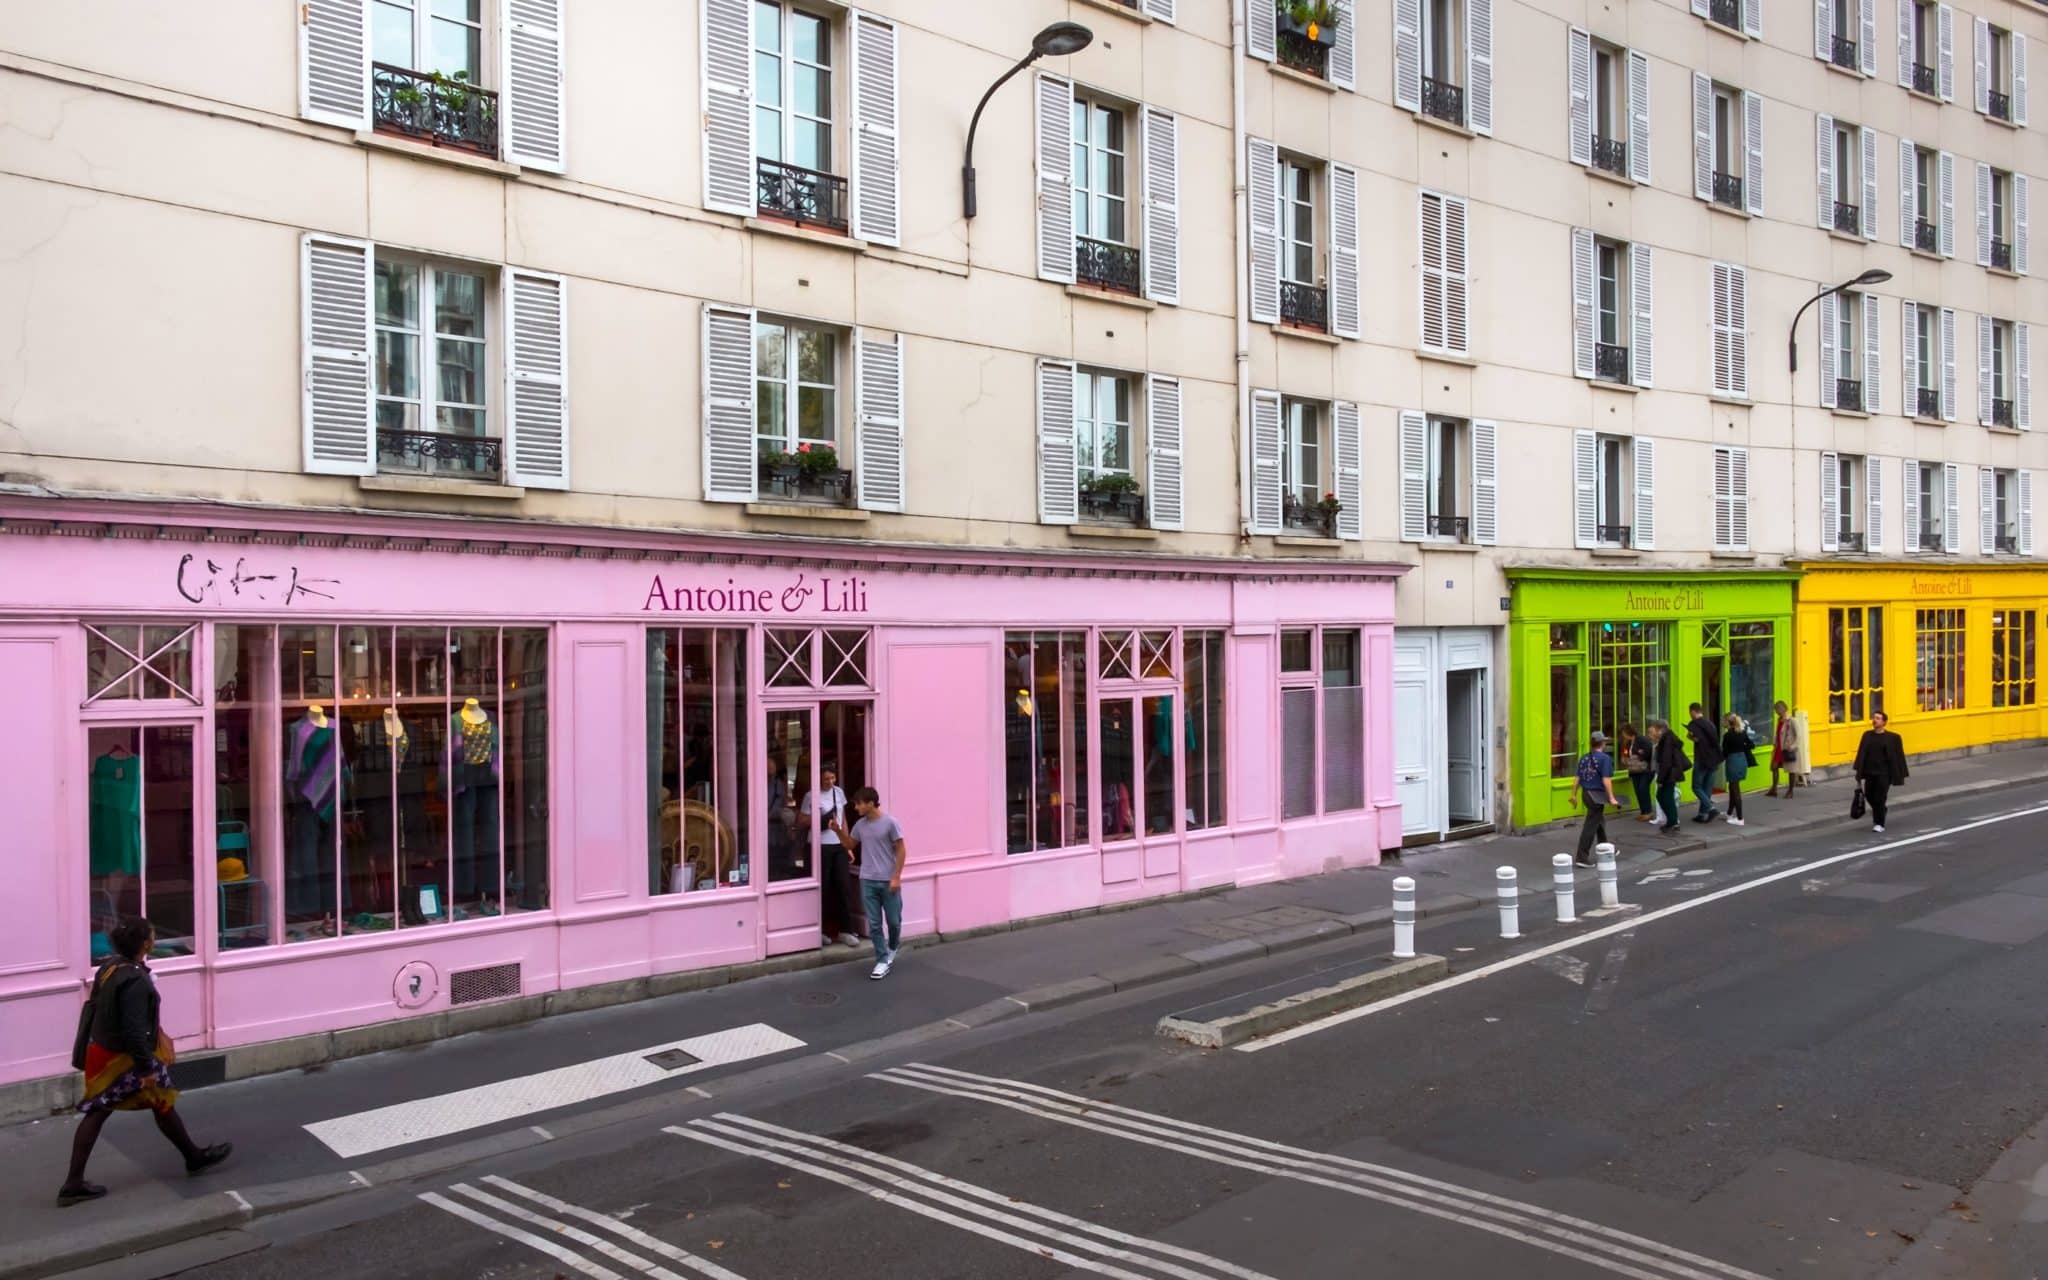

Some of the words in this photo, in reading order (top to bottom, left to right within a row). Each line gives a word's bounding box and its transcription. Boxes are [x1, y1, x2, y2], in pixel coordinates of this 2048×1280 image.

[642, 574, 773, 612] Antoine
[781, 574, 813, 612] &
[820, 577, 868, 612] Lili
[1911, 577, 1946, 594] Antoine
[1957, 576, 1972, 595] Lili
[1625, 591, 1671, 610] Antoine
[1673, 592, 1686, 610] &
[1686, 590, 1704, 610] Lili
